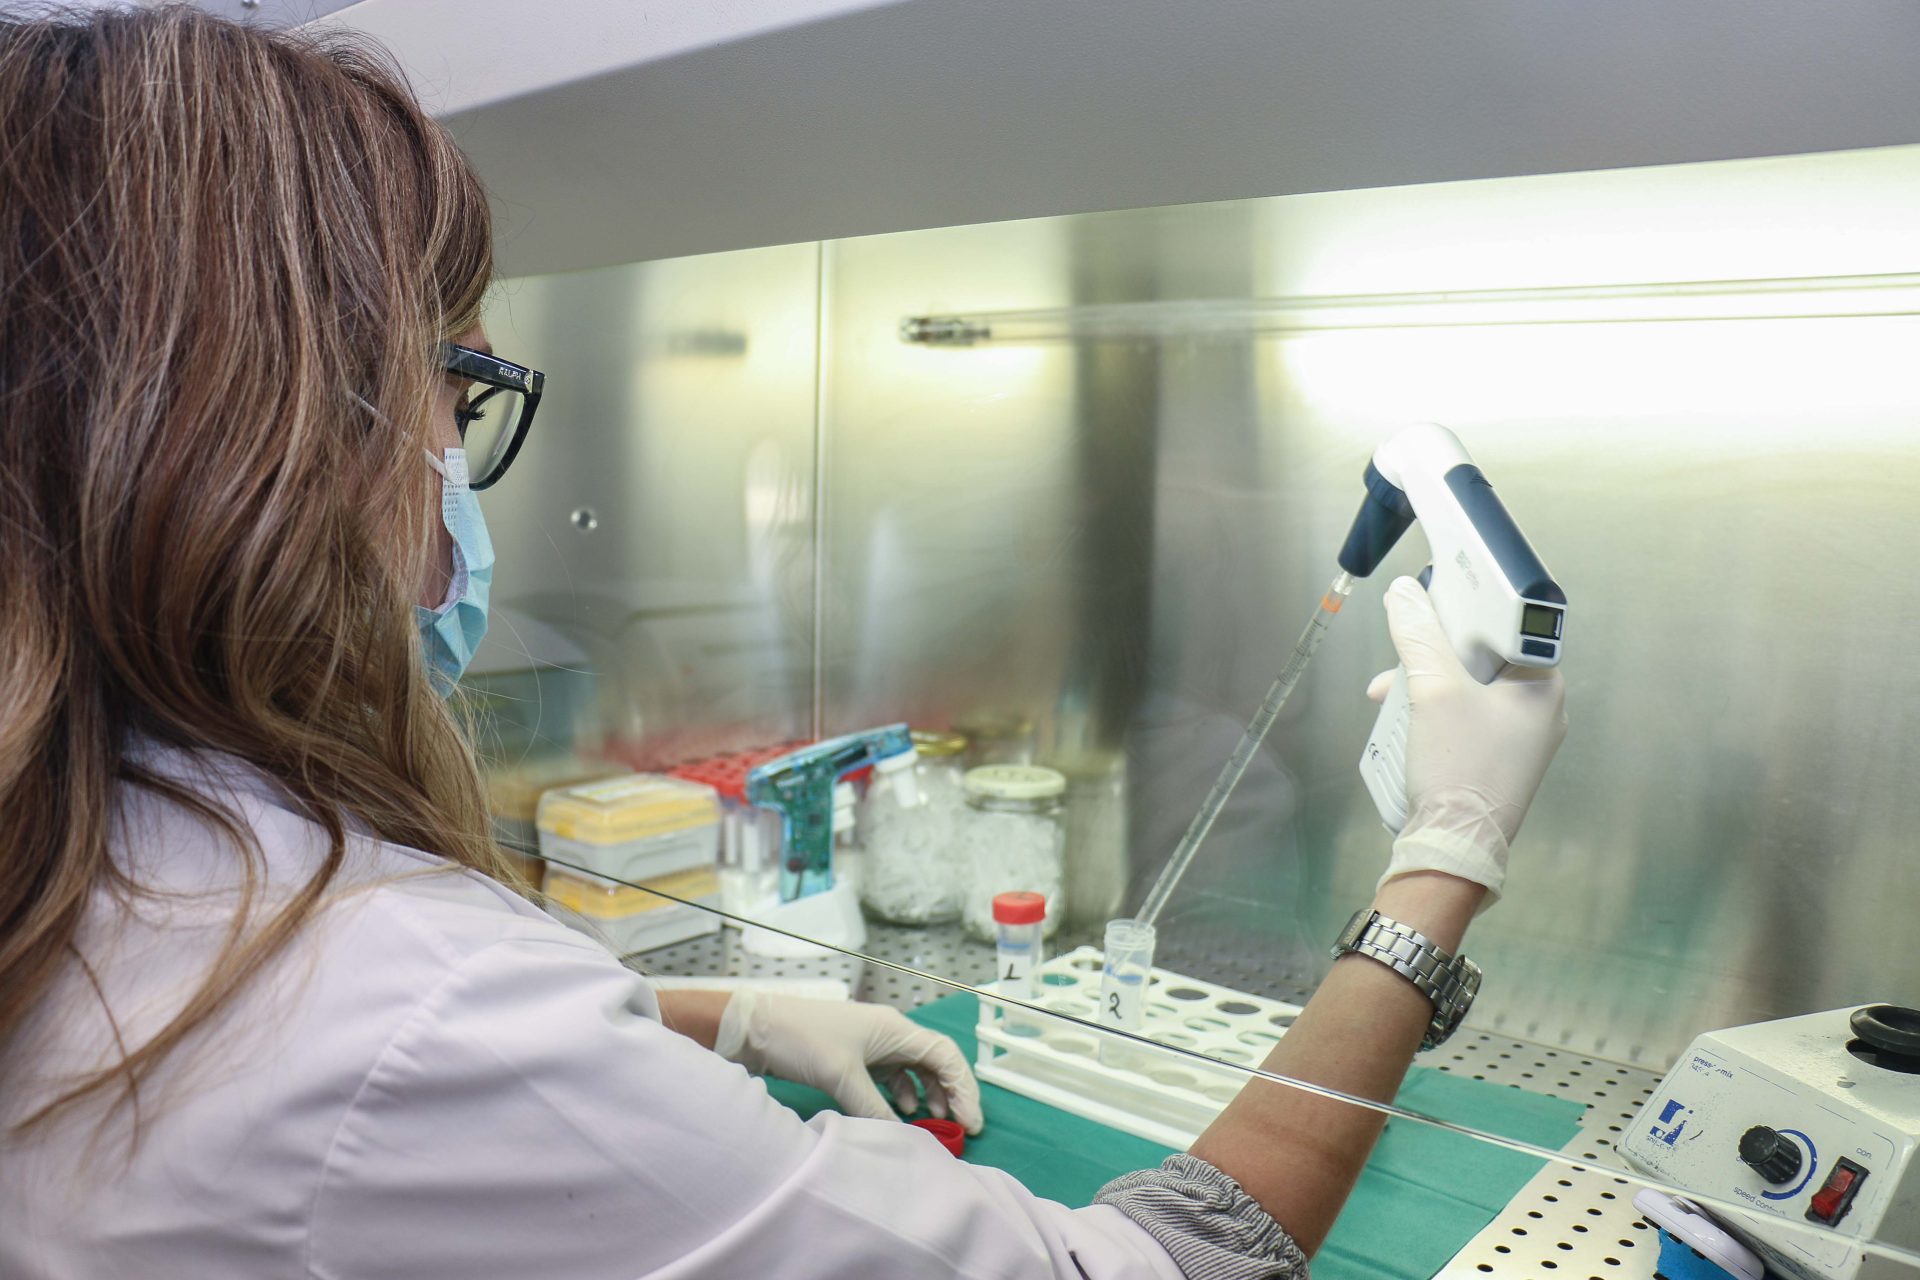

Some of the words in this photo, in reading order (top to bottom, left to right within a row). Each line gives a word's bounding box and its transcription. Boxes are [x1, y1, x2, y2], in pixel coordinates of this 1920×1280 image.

[498, 367, 522, 381] RALPH
[1109, 992, 1122, 1020] 2
[1733, 1186, 1756, 1203] speed
